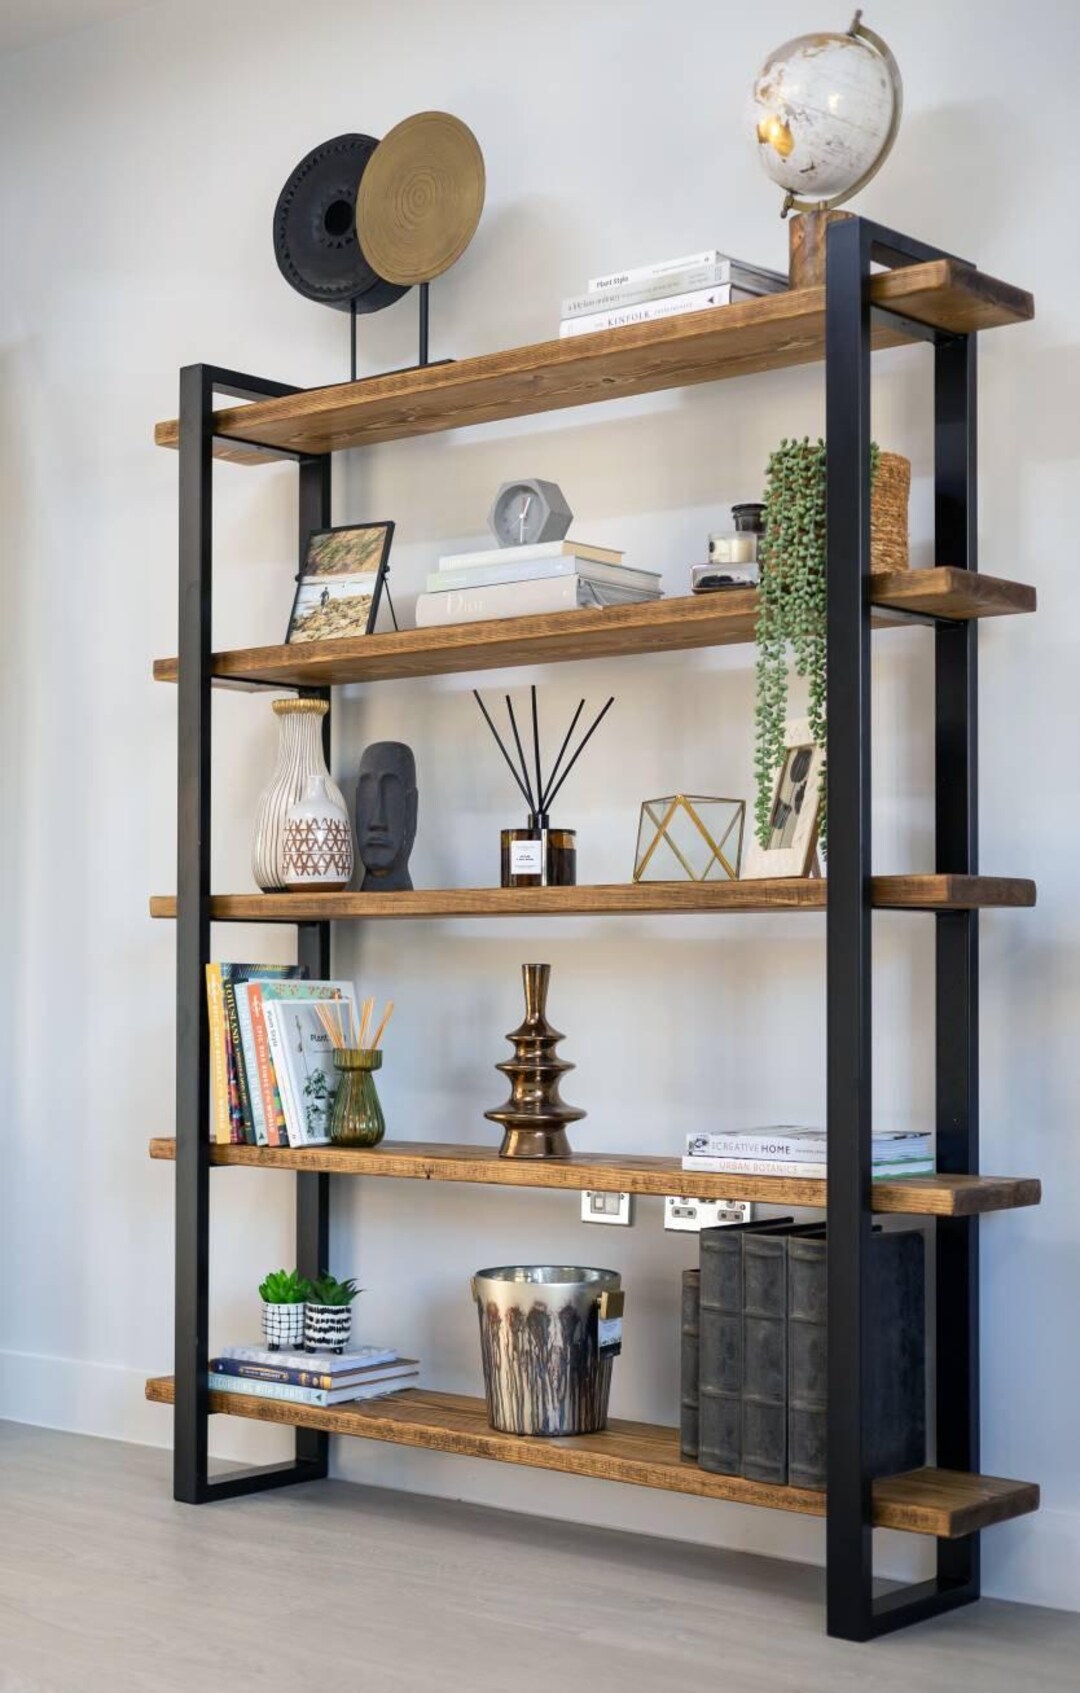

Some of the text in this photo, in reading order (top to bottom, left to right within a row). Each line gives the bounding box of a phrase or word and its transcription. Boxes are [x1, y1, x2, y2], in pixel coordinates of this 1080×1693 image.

[596, 274, 629, 289] Plant Style
[607, 310, 650, 328] KINFOLK
[760, 1144, 791, 1155] HOME
[719, 1160, 751, 1172] URBAN
[753, 1162, 798, 1174] BOTANICS
